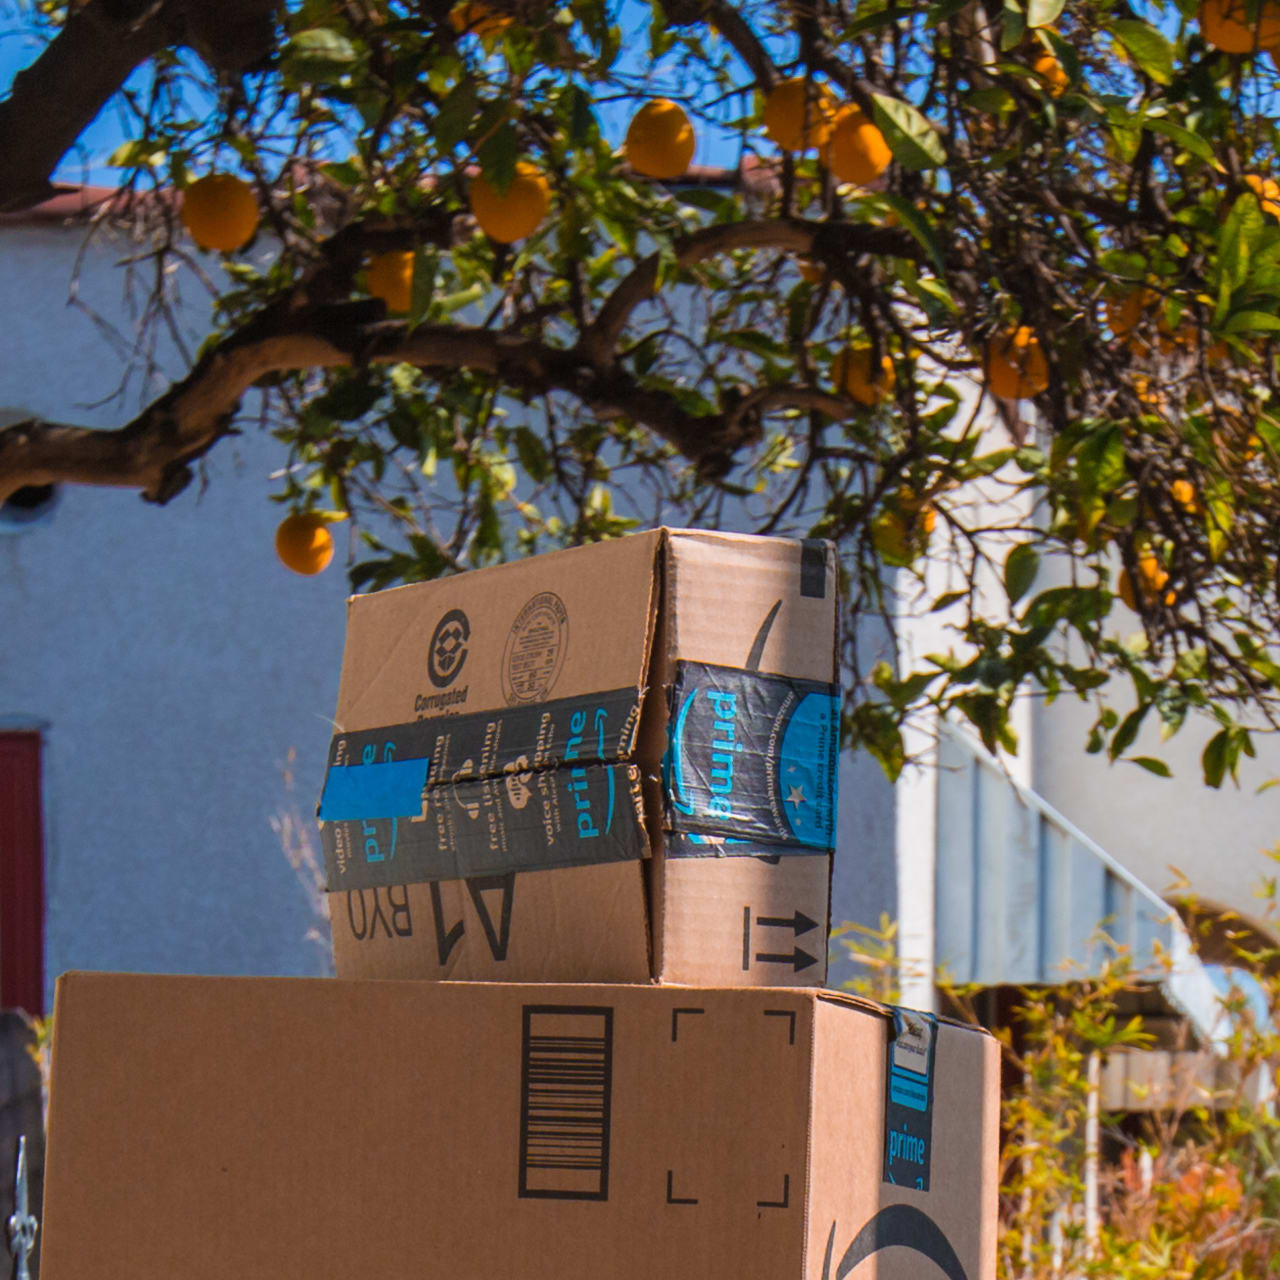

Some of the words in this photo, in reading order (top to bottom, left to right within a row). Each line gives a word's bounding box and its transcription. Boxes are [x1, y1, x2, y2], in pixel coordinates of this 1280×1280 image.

[705, 690, 744, 821] prime
[361, 743, 386, 863] pre
[541, 800, 555, 847] voice
[334, 828, 347, 875] video
[435, 813, 449, 852] free
[486, 811, 499, 851] free
[889, 1123, 925, 1165] prime
